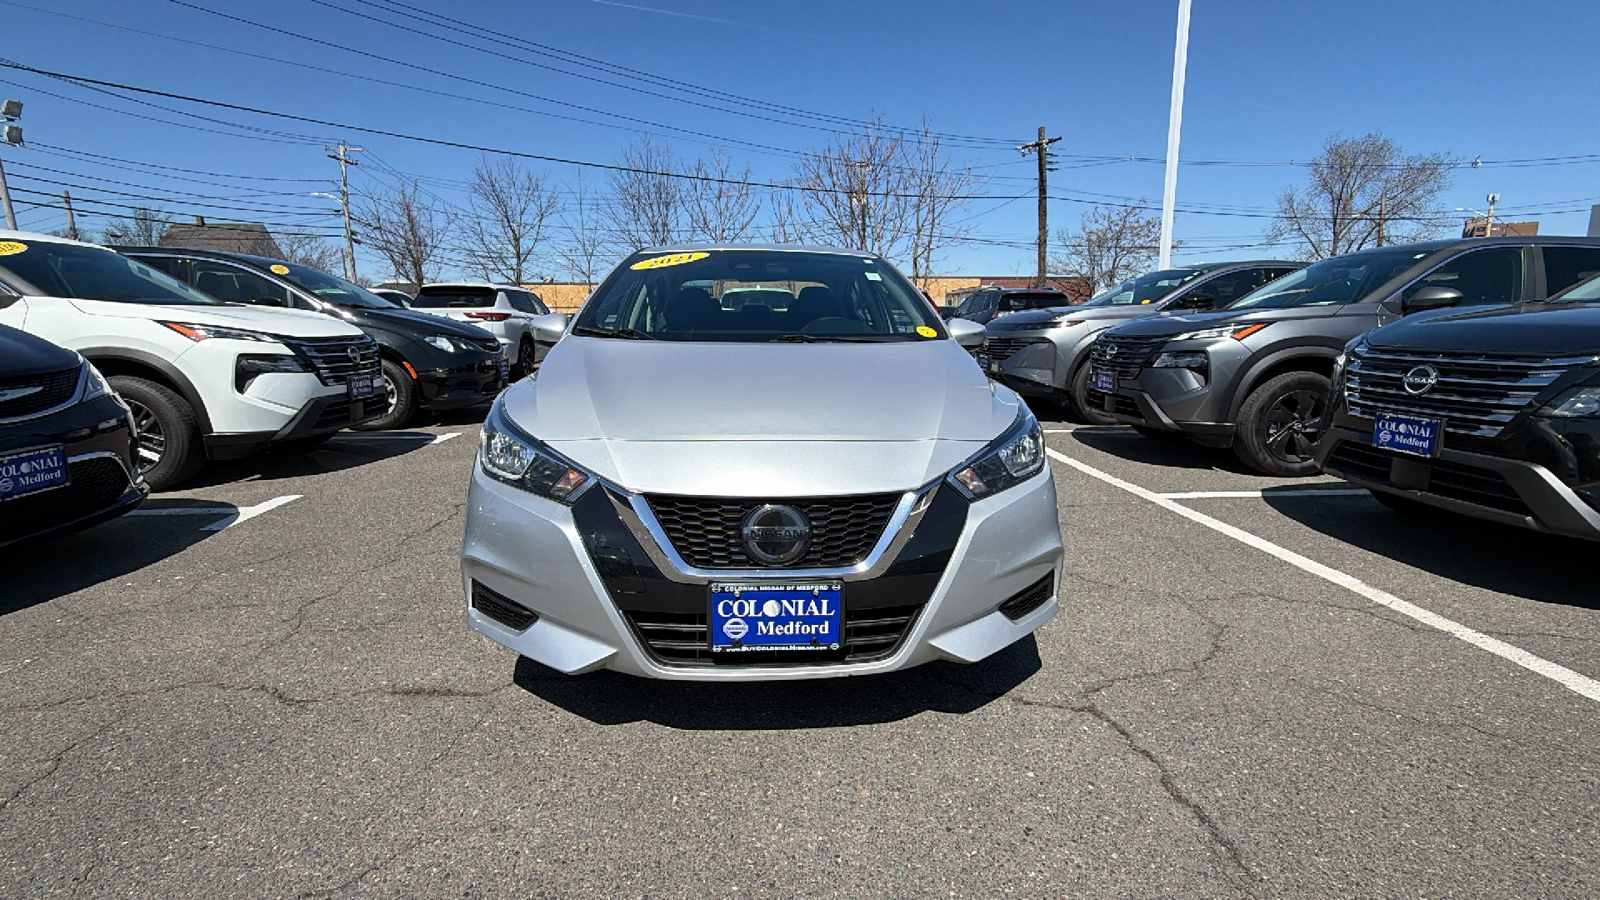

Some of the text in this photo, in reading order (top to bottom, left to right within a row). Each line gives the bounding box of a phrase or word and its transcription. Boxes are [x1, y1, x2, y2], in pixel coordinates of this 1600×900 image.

[1378, 420, 1434, 438] COLONIAL
[1394, 434, 1429, 449] Medford
[0, 456, 63, 479] OLONIAL
[19, 469, 61, 487] Medford
[749, 529, 802, 539] NISSAN
[717, 599, 836, 618] COLONIAL
[756, 621, 829, 636] Medford
